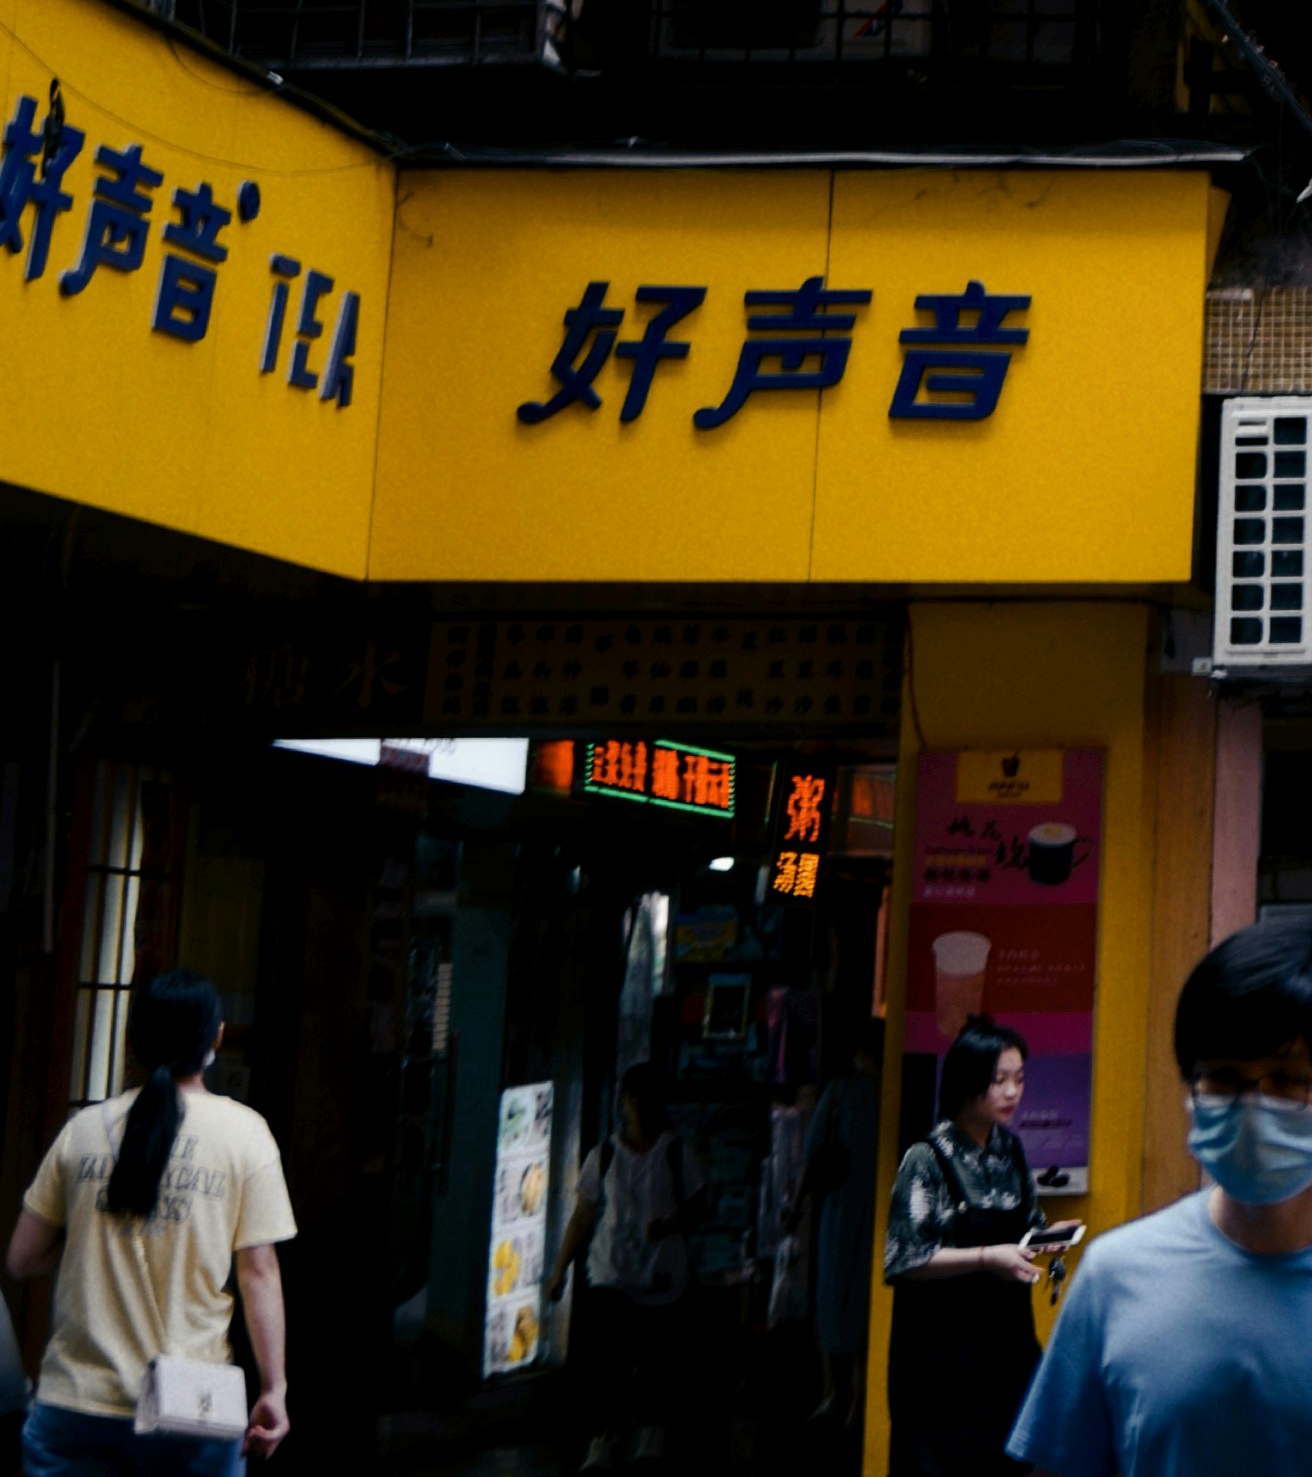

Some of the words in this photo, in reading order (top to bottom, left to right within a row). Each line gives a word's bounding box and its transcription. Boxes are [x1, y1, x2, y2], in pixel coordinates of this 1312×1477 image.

[0, 95, 232, 343] 好声音
[260, 252, 361, 409] TEA
[517, 276, 1033, 429] 好声音
